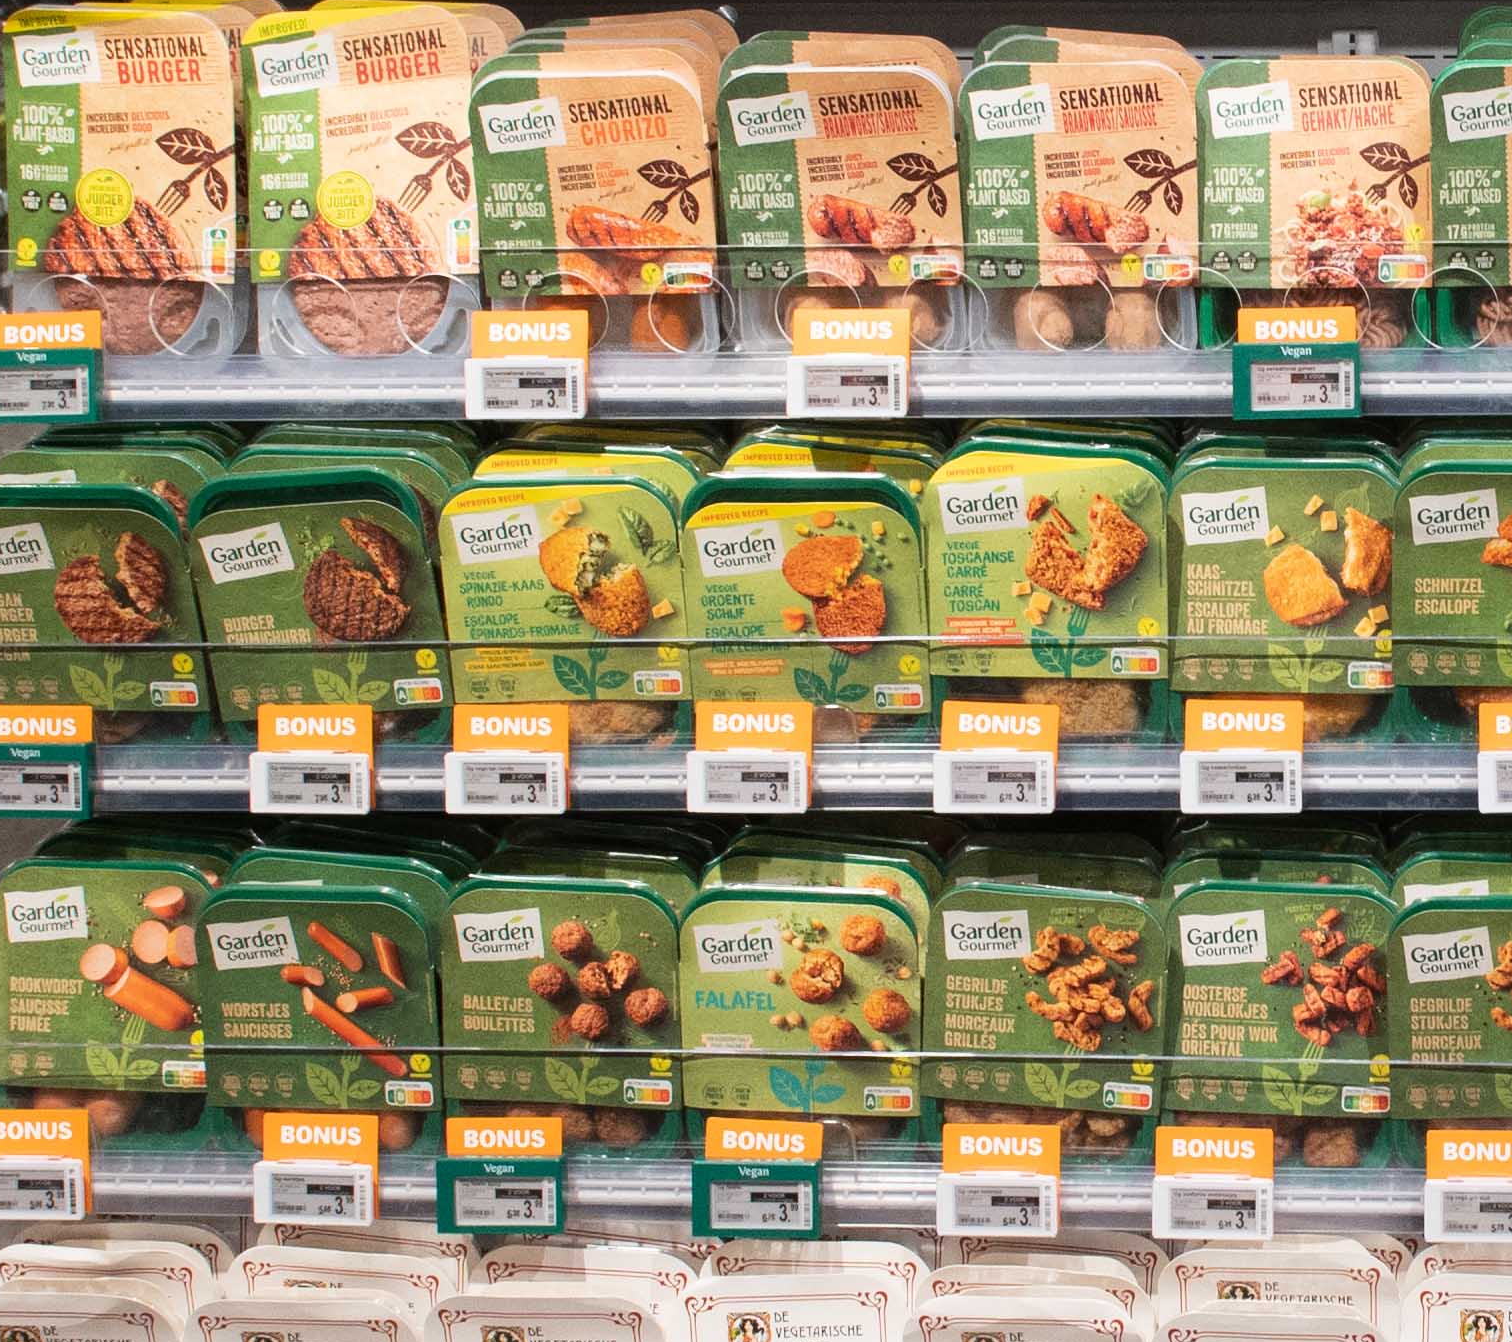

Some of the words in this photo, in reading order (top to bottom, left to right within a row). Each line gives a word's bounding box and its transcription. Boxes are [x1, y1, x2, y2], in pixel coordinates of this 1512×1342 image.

[22, 42, 89, 65] Garden
[104, 36, 207, 60] SENSATIONAL
[31, 59, 87, 79] Gourmet
[118, 59, 202, 84] BURGER
[1299, 81, 1402, 108] SENSATIONAL
[22, 104, 64, 123] 100%
[569, 93, 673, 124] SENSATIONAL
[581, 115, 668, 146] CHORIZO
[823, 108, 918, 136] BRAADWORST/SAUCISSE
[4, 323, 85, 344] BONUS
[1254, 319, 1339, 339] BONUS
[16, 351, 47, 364] Vegan
[941, 550, 1015, 566] TOSCAANSE
[1187, 564, 1225, 580] KAAS-
[458, 578, 545, 595] SPINAZIE-KAAS
[1187, 579, 1256, 598] SCHNITZEL
[466, 595, 503, 608] RONDO
[701, 593, 756, 607] GROENTE
[949, 599, 1000, 612] TOSCAN
[707, 606, 745, 621] SCHIJF
[1187, 601, 1251, 619] ESCALOPE
[223, 614, 275, 633] BURGER
[1187, 618, 1205, 635] AU
[1208, 617, 1269, 635] FROMAGE
[958, 713, 1041, 736] BONUS
[9, 976, 83, 996] ROOKWORST
[946, 975, 1008, 995] GEGRILDE
[1183, 984, 1247, 1003] OOSTERSE
[9, 996, 69, 1017] SAUCISSE
[463, 995, 533, 1013] BALLETJES
[695, 990, 776, 1012] FALAFEL
[946, 993, 1003, 1012] STUKJES
[1183, 1000, 1268, 1019] WOKBLOKJES
[222, 1003, 289, 1020] WORSTJES
[223, 1022, 292, 1040] SAUCISSES
[463, 1015, 534, 1033] BOULETTES
[945, 1014, 1014, 1034] MORCEAUX
[1213, 1022, 1244, 1040] POUR
[1247, 1025, 1278, 1043] WOK
[1181, 1039, 1243, 1057] ORIENTAL
[280, 1125, 361, 1147] BONUS
[43, 1326, 58, 1336] DE
